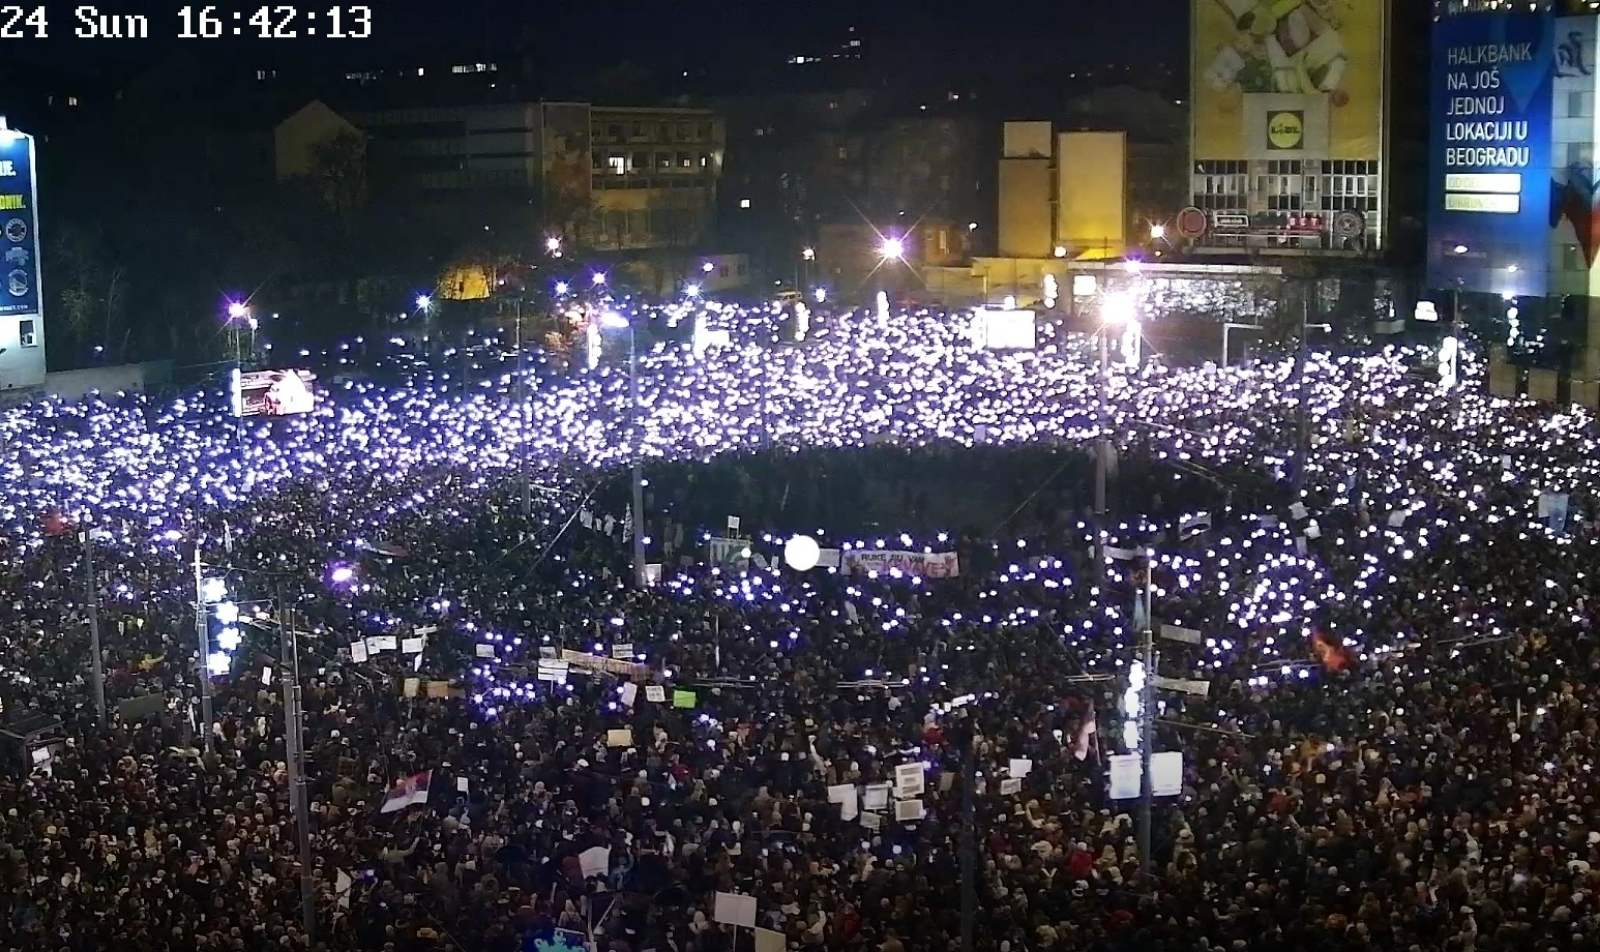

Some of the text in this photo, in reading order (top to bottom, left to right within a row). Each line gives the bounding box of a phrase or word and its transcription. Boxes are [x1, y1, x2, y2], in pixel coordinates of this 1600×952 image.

[1448, 42, 1533, 64] HALKBANK
[1447, 66, 1501, 90] NA JOŠ
[1446, 96, 1505, 115] JEDNOJ
[1446, 120, 1528, 141] LOKACIJI U
[1446, 146, 1530, 167] BEOGRADU
